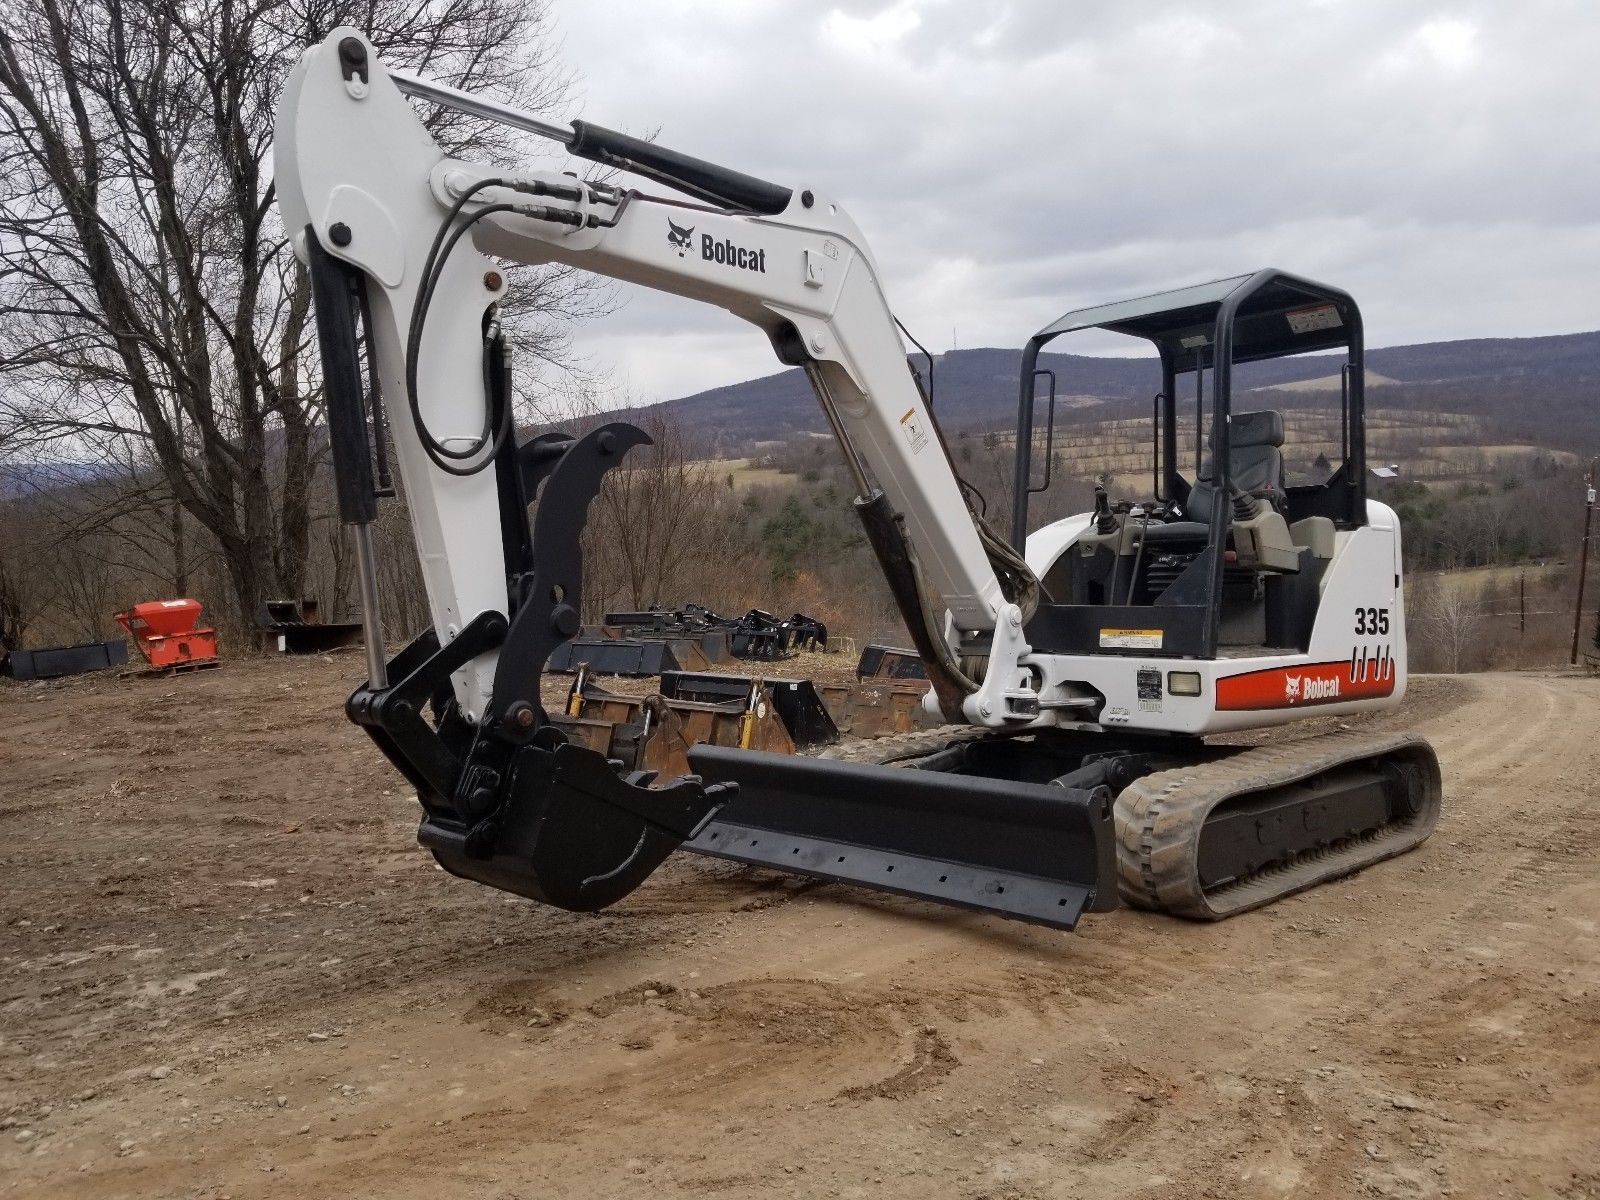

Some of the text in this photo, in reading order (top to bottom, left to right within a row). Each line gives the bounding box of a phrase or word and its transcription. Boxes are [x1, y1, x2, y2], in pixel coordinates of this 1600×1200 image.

[702, 234, 766, 273] Bobcat
[1354, 607, 1389, 635] 335
[1303, 675, 1339, 699] Bobcat
